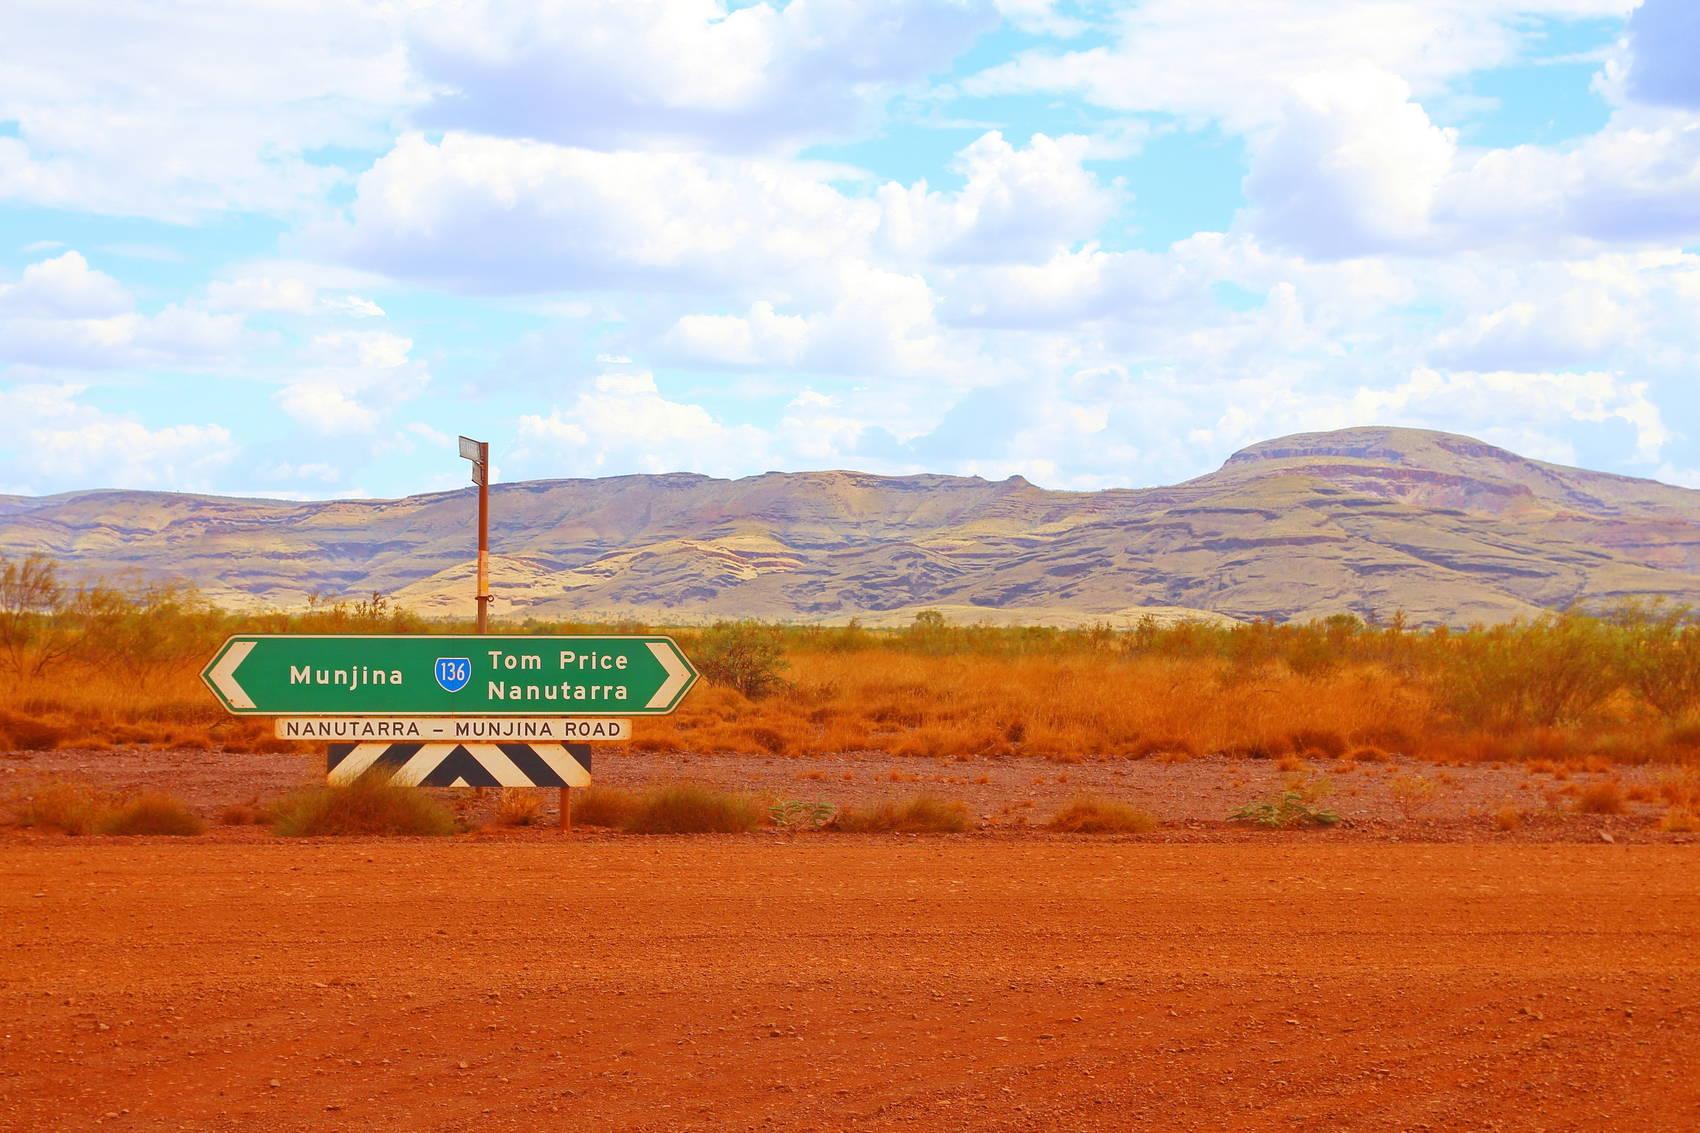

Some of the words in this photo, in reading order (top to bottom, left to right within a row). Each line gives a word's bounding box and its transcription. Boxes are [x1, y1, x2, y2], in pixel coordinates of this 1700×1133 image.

[487, 650, 542, 670] Tom
[560, 650, 628, 670] Price
[290, 665, 403, 691] Munjina
[440, 662, 465, 681] 136
[488, 681, 627, 700] Nanutarra
[286, 721, 421, 737] NANUTARRA
[455, 721, 553, 737] MUNJINA
[564, 721, 621, 737] ROAD
